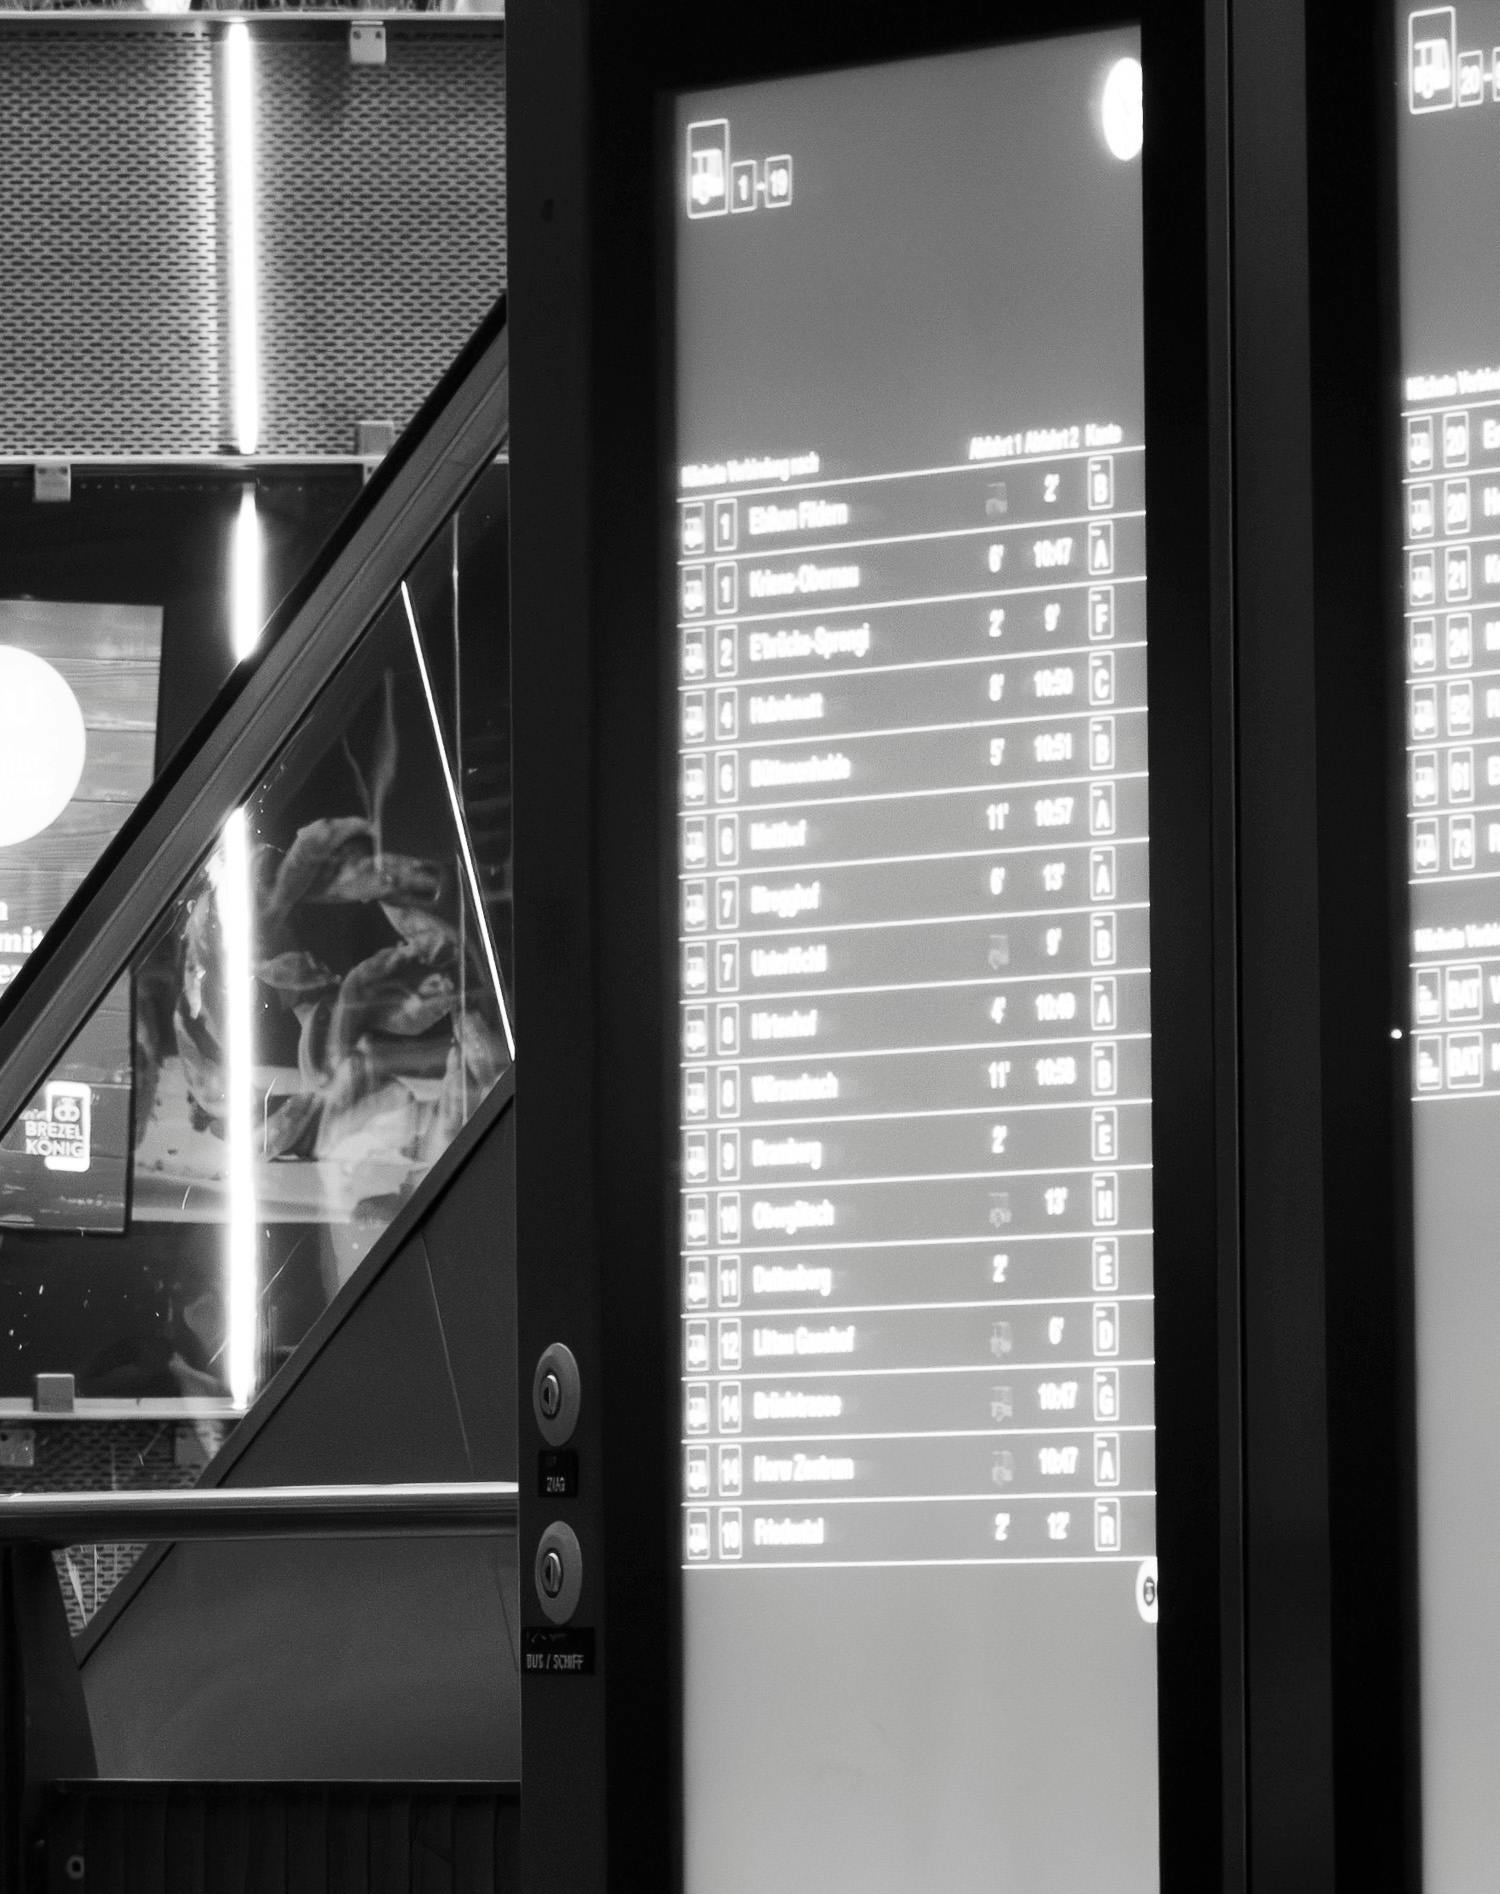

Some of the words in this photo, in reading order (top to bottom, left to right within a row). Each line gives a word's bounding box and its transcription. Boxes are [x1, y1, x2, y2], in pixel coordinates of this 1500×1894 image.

[720, 513, 737, 540] 1
[1093, 475, 1108, 507] B
[720, 576, 737, 604] 1
[1093, 540, 1112, 571] A
[720, 637, 738, 669] 2
[1095, 605, 1109, 633] F
[720, 699, 738, 732] 4
[1093, 670, 1113, 699] C
[721, 762, 739, 795] 6
[1094, 735, 1111, 764] B
[721, 825, 739, 858] 6
[1094, 799, 1114, 830] A
[721, 888, 739, 921] 7
[1095, 865, 1114, 894] B
[722, 951, 740, 984] 7
[1096, 929, 1115, 960] A
[722, 1014, 740, 1048] 8
[1096, 995, 1115, 1024] B
[722, 1078, 740, 1111] 8
[1096, 1059, 1116, 1090] B
[25, 1122, 84, 1139] BREZEL
[25, 1137, 85, 1156] KÖNIG
[723, 1141, 740, 1174] 9
[1097, 1124, 1116, 1155] E
[1097, 1189, 1117, 1220] H
[1098, 1254, 1117, 1285] E
[1098, 1319, 1118, 1350] D
[1099, 1384, 1118, 1415] G
[1099, 1449, 1119, 1480] A
[1100, 1514, 1119, 1545] R
